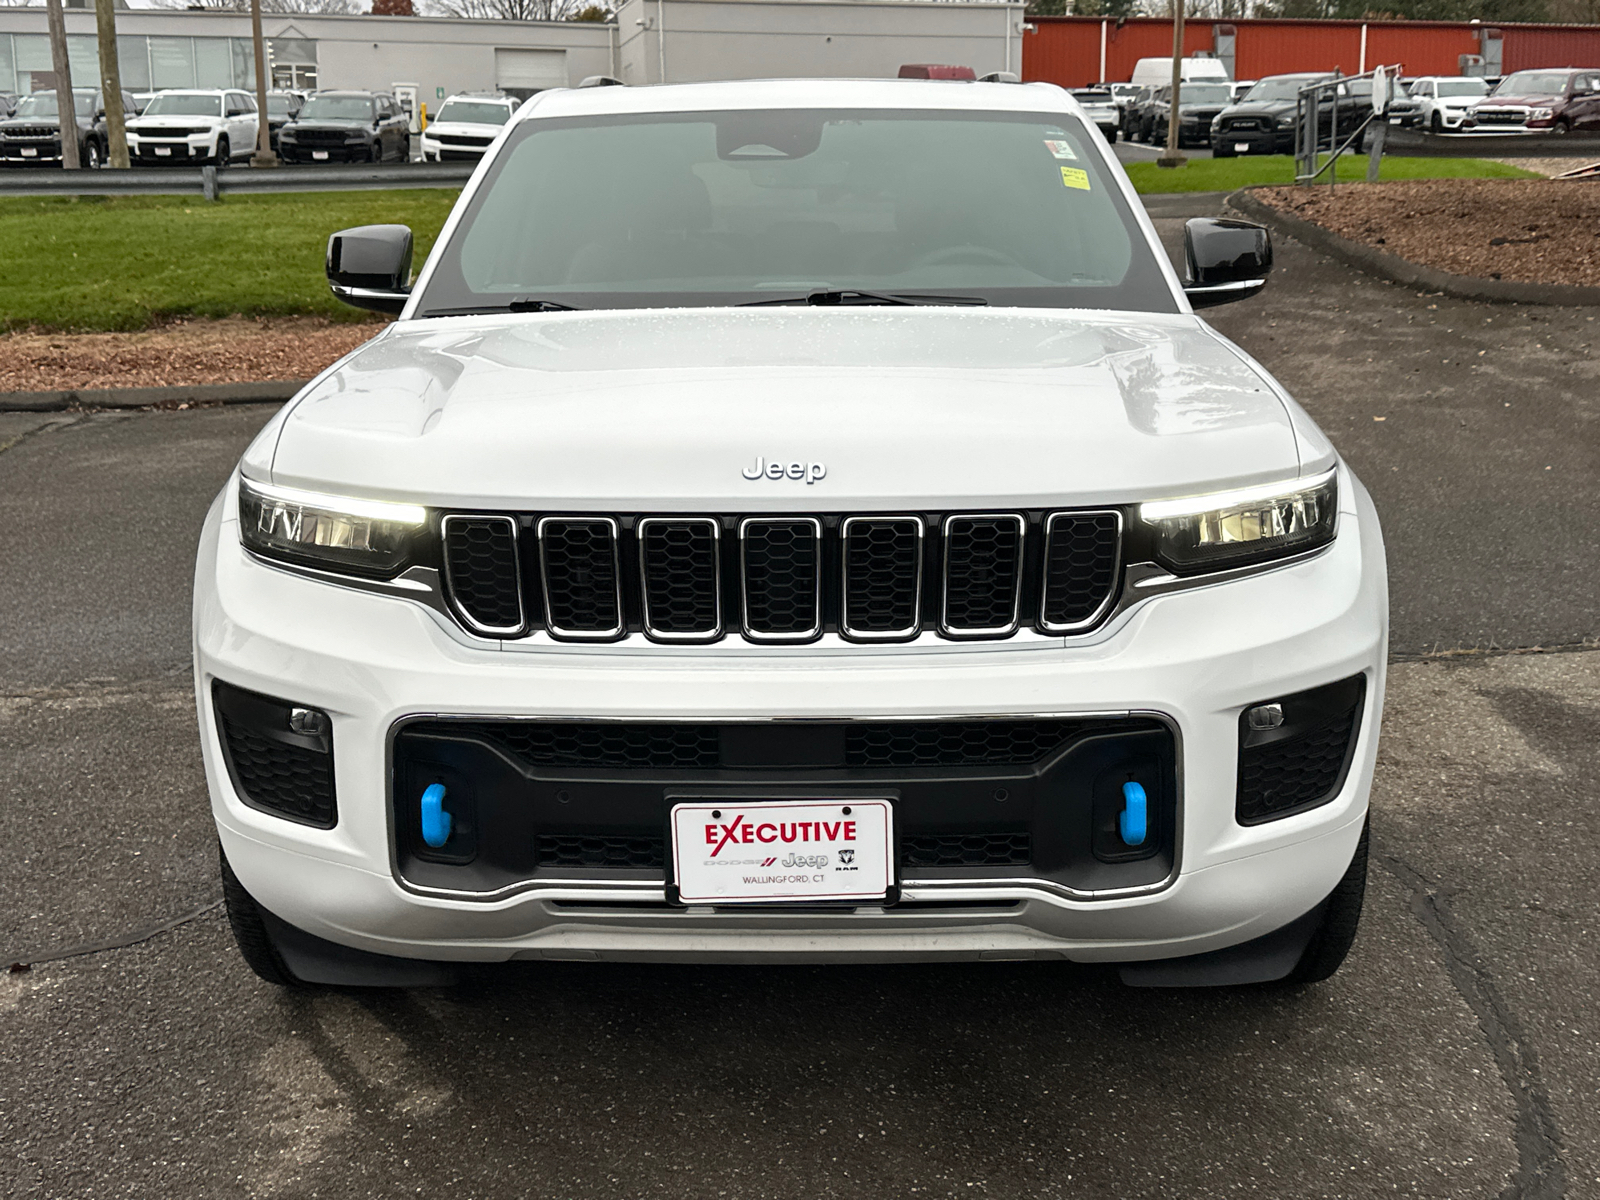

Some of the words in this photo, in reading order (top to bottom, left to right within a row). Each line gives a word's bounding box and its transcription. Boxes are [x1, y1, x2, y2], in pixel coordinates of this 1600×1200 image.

[742, 456, 827, 485] Jeep
[705, 815, 856, 857] EXECUTIVE
[782, 852, 828, 869] Jeep
[742, 875, 811, 884] WALLINGFORD,
[812, 874, 825, 883] CT
